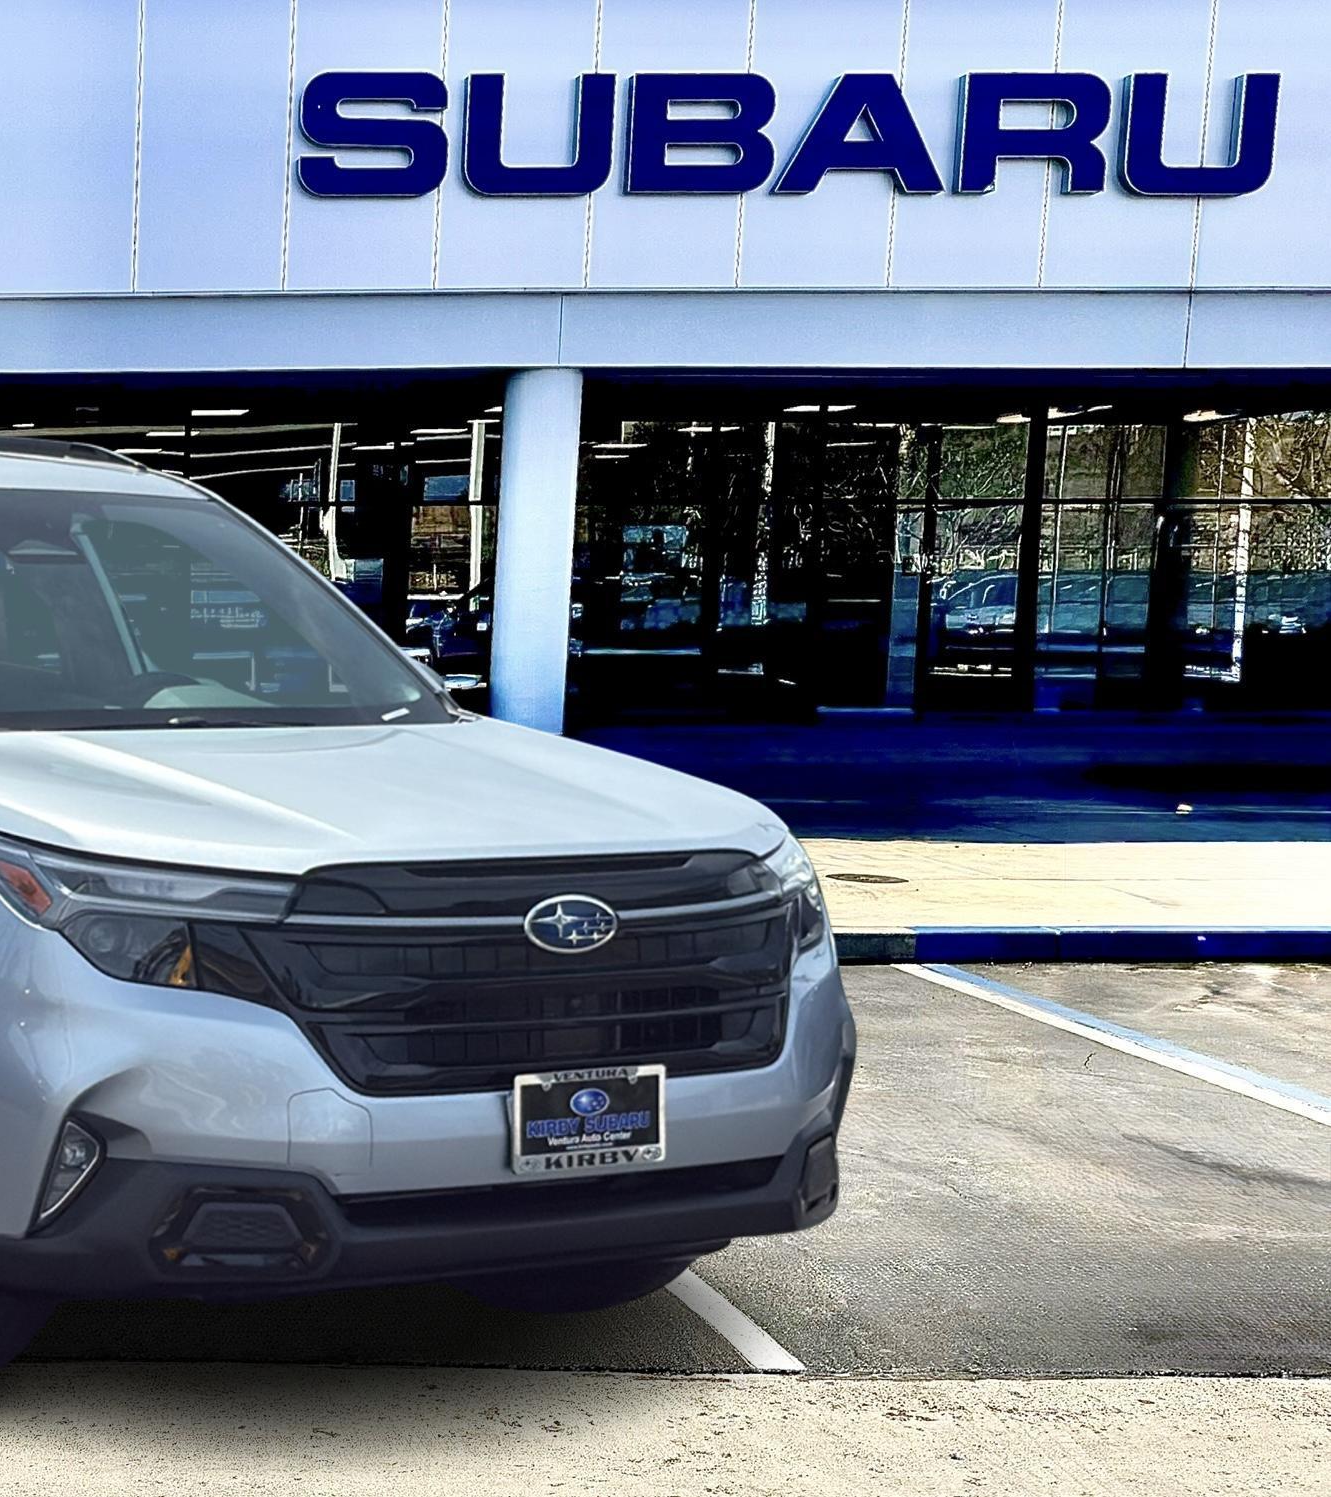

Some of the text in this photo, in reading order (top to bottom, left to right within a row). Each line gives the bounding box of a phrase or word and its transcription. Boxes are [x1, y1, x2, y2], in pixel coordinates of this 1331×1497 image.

[298, 72, 1281, 199] SUBARU
[553, 1067, 629, 1082] VENTURA
[526, 1111, 651, 1138] KIRBY SUBARU
[548, 1135, 580, 1147] Ventura
[581, 1133, 602, 1144] Auto
[603, 1131, 632, 1142] Center
[544, 1149, 639, 1170] KIRBY
